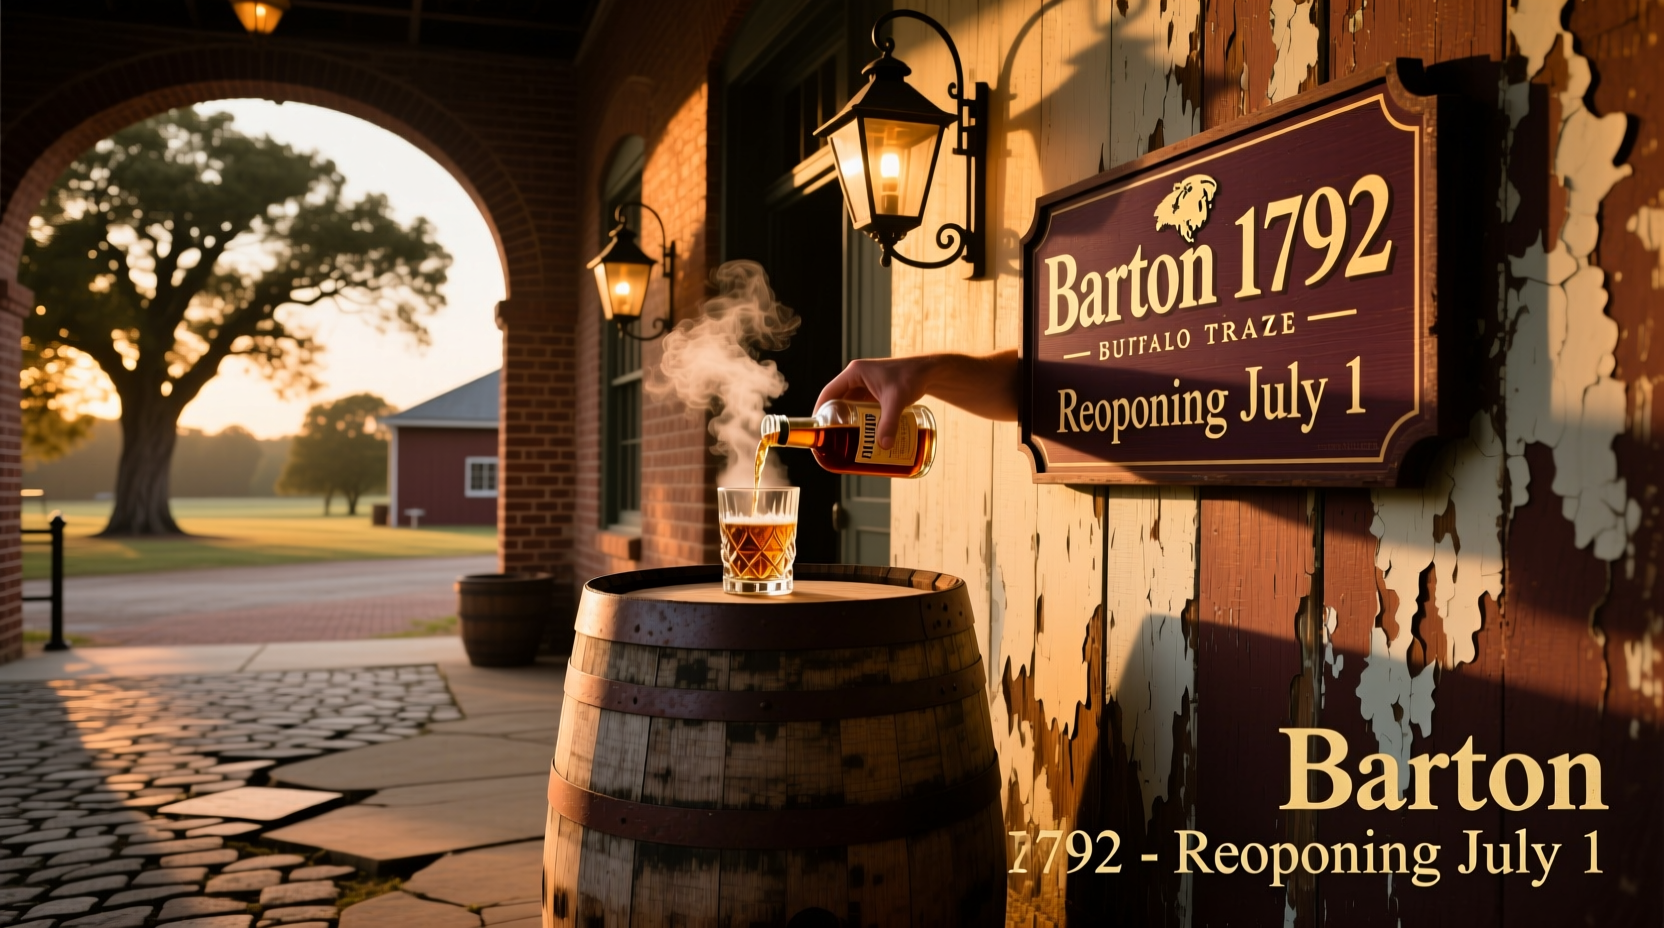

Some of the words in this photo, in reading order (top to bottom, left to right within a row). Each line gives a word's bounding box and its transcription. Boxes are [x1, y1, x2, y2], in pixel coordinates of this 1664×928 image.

[1044, 244, 1217, 336] Barton
[1233, 173, 1393, 299] 1792
[1204, 311, 1296, 344] TRAZE
[1057, 379, 1229, 445] Reoponing
[1240, 361, 1328, 434] July
[1345, 355, 1366, 414] 1
